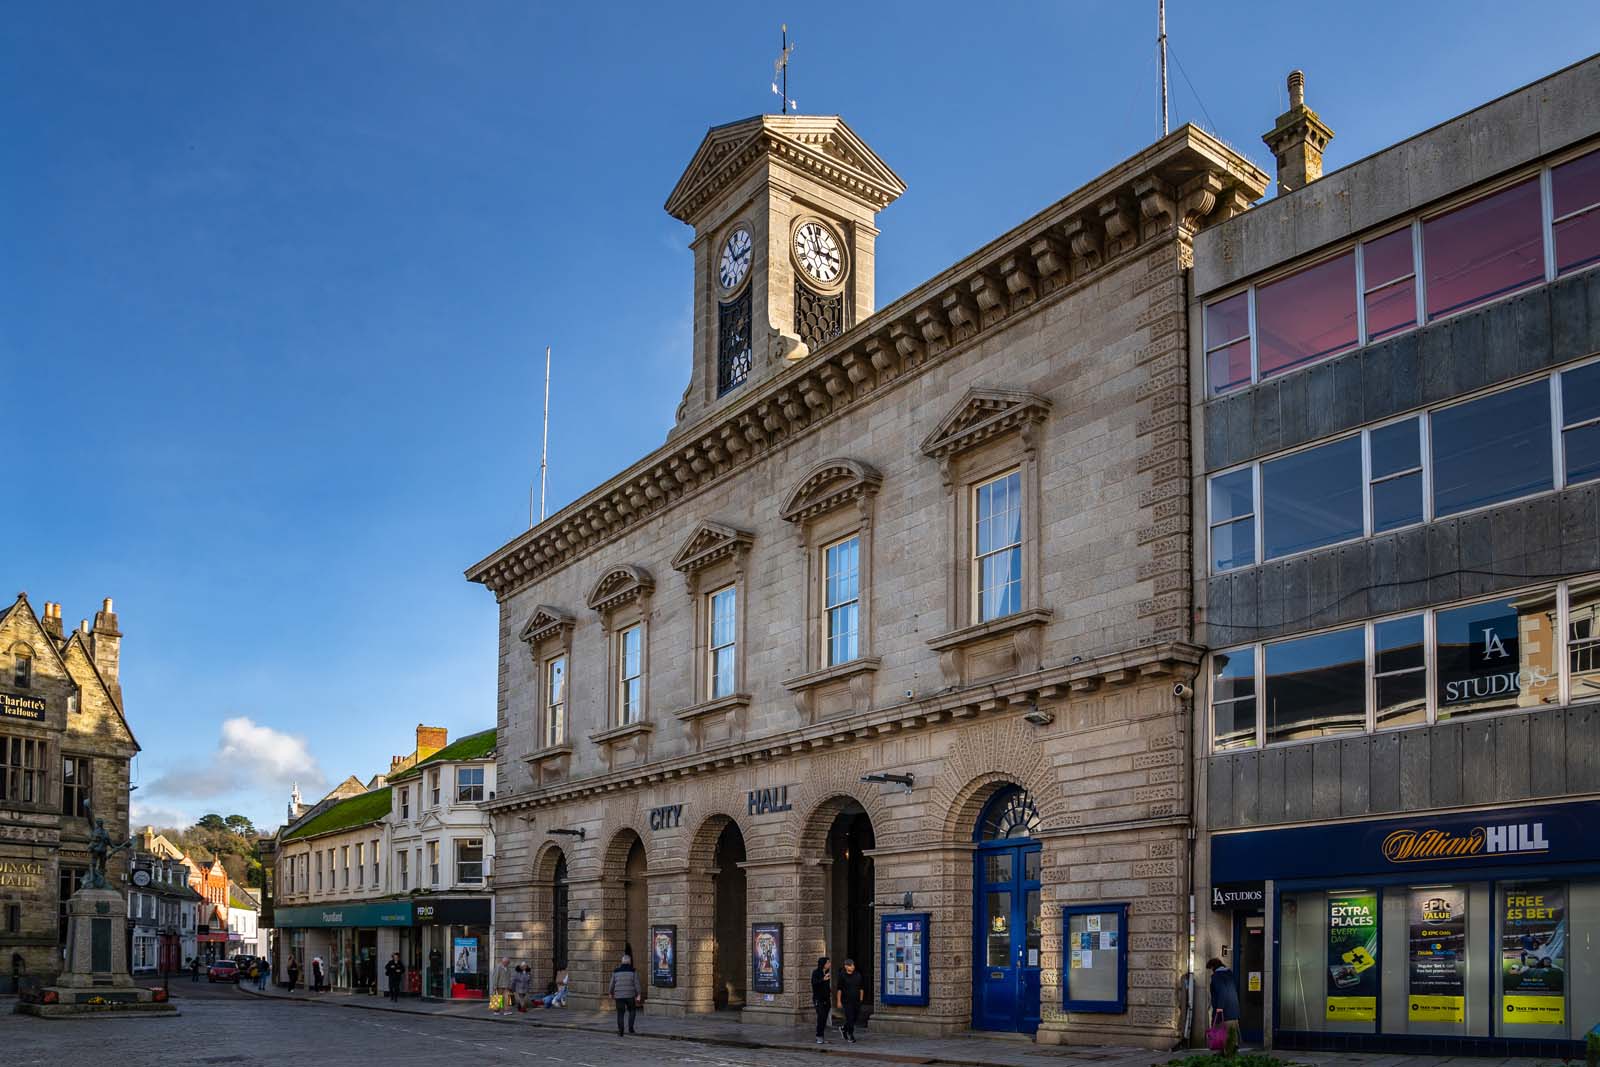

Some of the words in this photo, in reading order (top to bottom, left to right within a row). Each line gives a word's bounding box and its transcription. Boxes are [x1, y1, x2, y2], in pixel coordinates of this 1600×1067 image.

[1446, 668, 1547, 701] STUDIOS
[650, 804, 682, 831] CITY
[748, 785, 792, 816] HALL
[1382, 826, 1487, 863] William
[1487, 823, 1549, 853] HILL
[1225, 891, 1262, 901] STUDIOS
[1422, 900, 1452, 911] EPIC
[1507, 896, 1544, 908] FREE
[1331, 906, 1370, 916] EXTRA
[1423, 912, 1450, 920] VALUE
[1507, 909, 1523, 920] £5
[1526, 908, 1553, 919] BET
[1331, 916, 1374, 927] PLACES
[1331, 927, 1358, 936] EVERY
[1331, 935, 1346, 943] DAY
